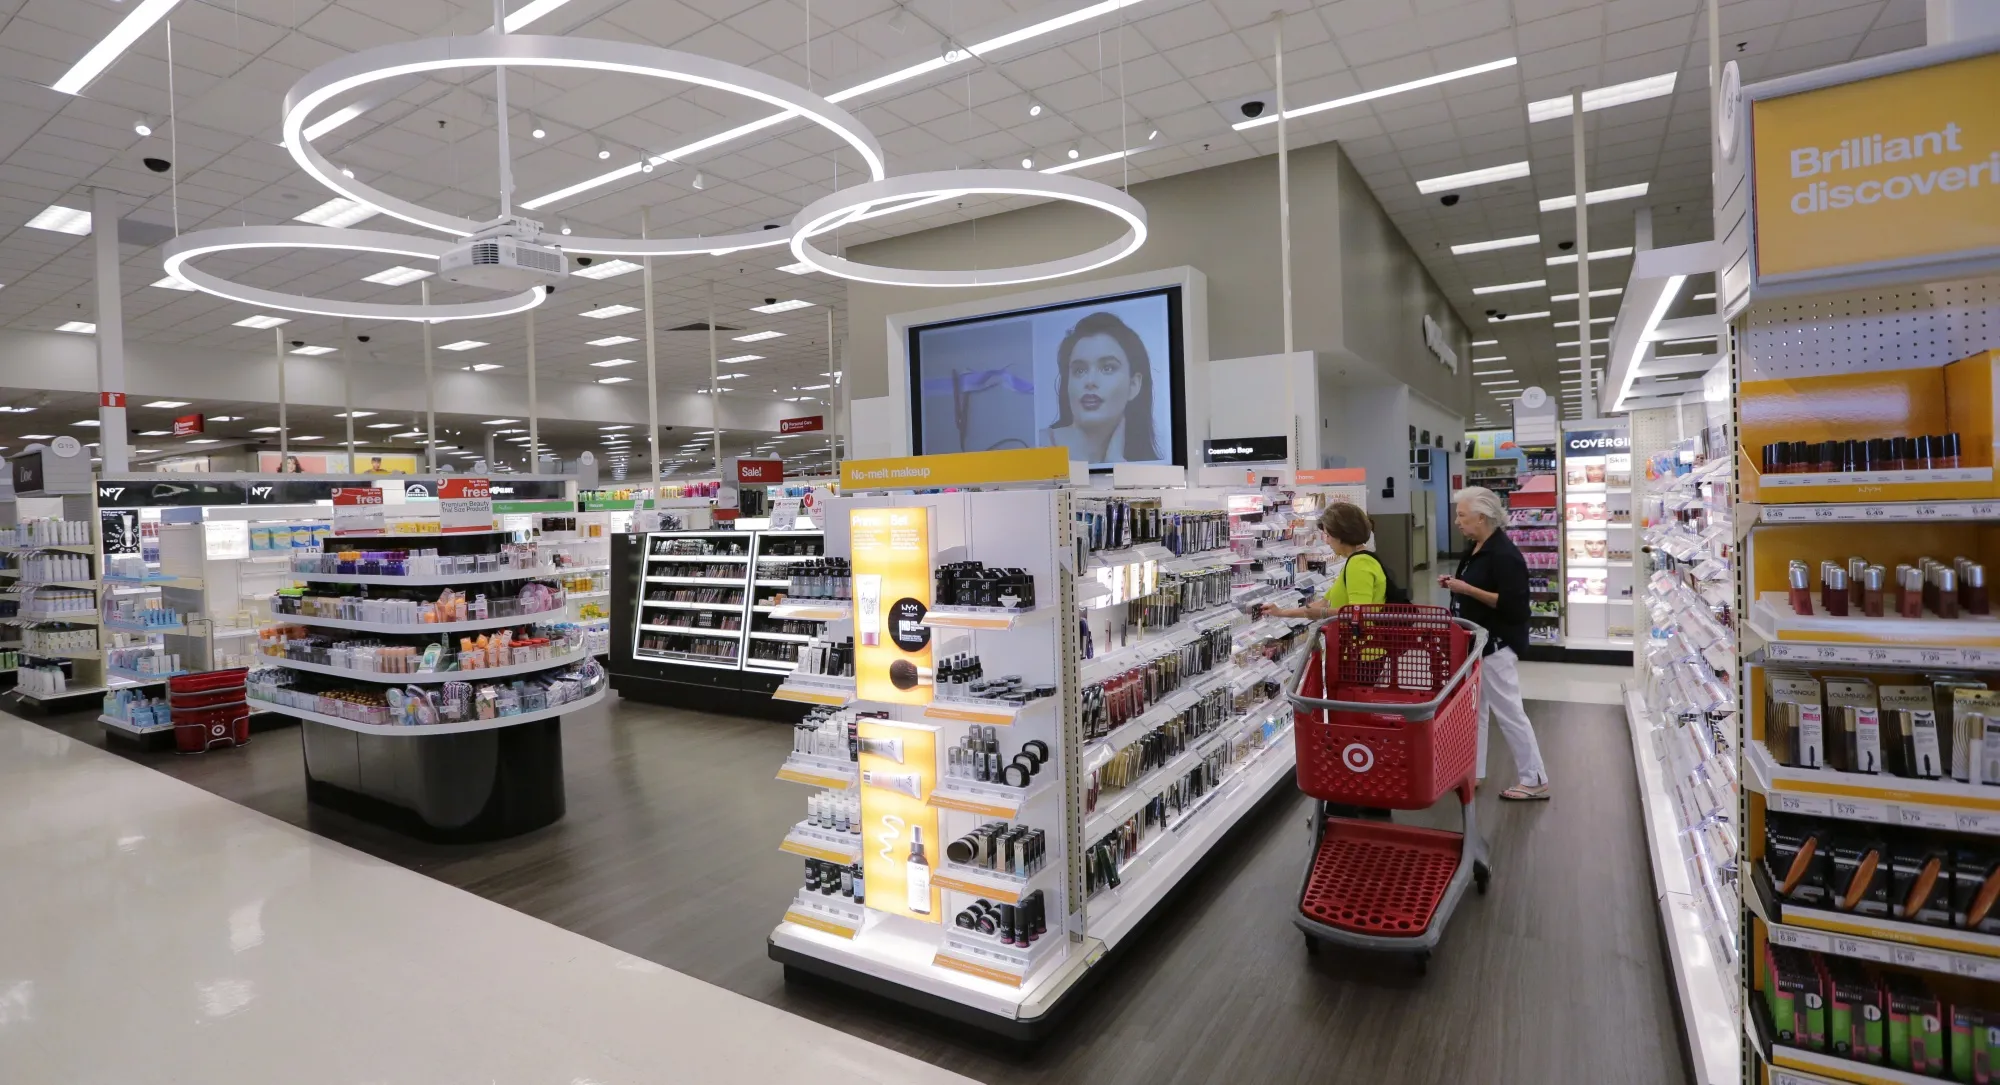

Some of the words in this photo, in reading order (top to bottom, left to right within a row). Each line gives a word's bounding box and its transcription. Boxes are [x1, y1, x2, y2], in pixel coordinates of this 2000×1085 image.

[1790, 122, 1963, 179] Brilliant
[1208, 447, 1236, 456] Cosmetic
[1237, 446, 1253, 455] Bags
[1609, 456, 1628, 464] Skin
[742, 466, 762, 477] Sale!
[851, 467, 889, 480] No-melt
[891, 466, 930, 479] makeup
[462, 486, 489, 498] free
[355, 494, 382, 504] free
[469, 500, 490, 508] Beauty
[901, 603, 918, 612] NYX
[1868, 652, 1886, 660] 7.99
[1774, 688, 1816, 697] VOLUMINOUS
[1783, 801, 1800, 809] 5.79
[1838, 807, 1855, 815] 5.79
[1780, 935, 1797, 943] 6.89
